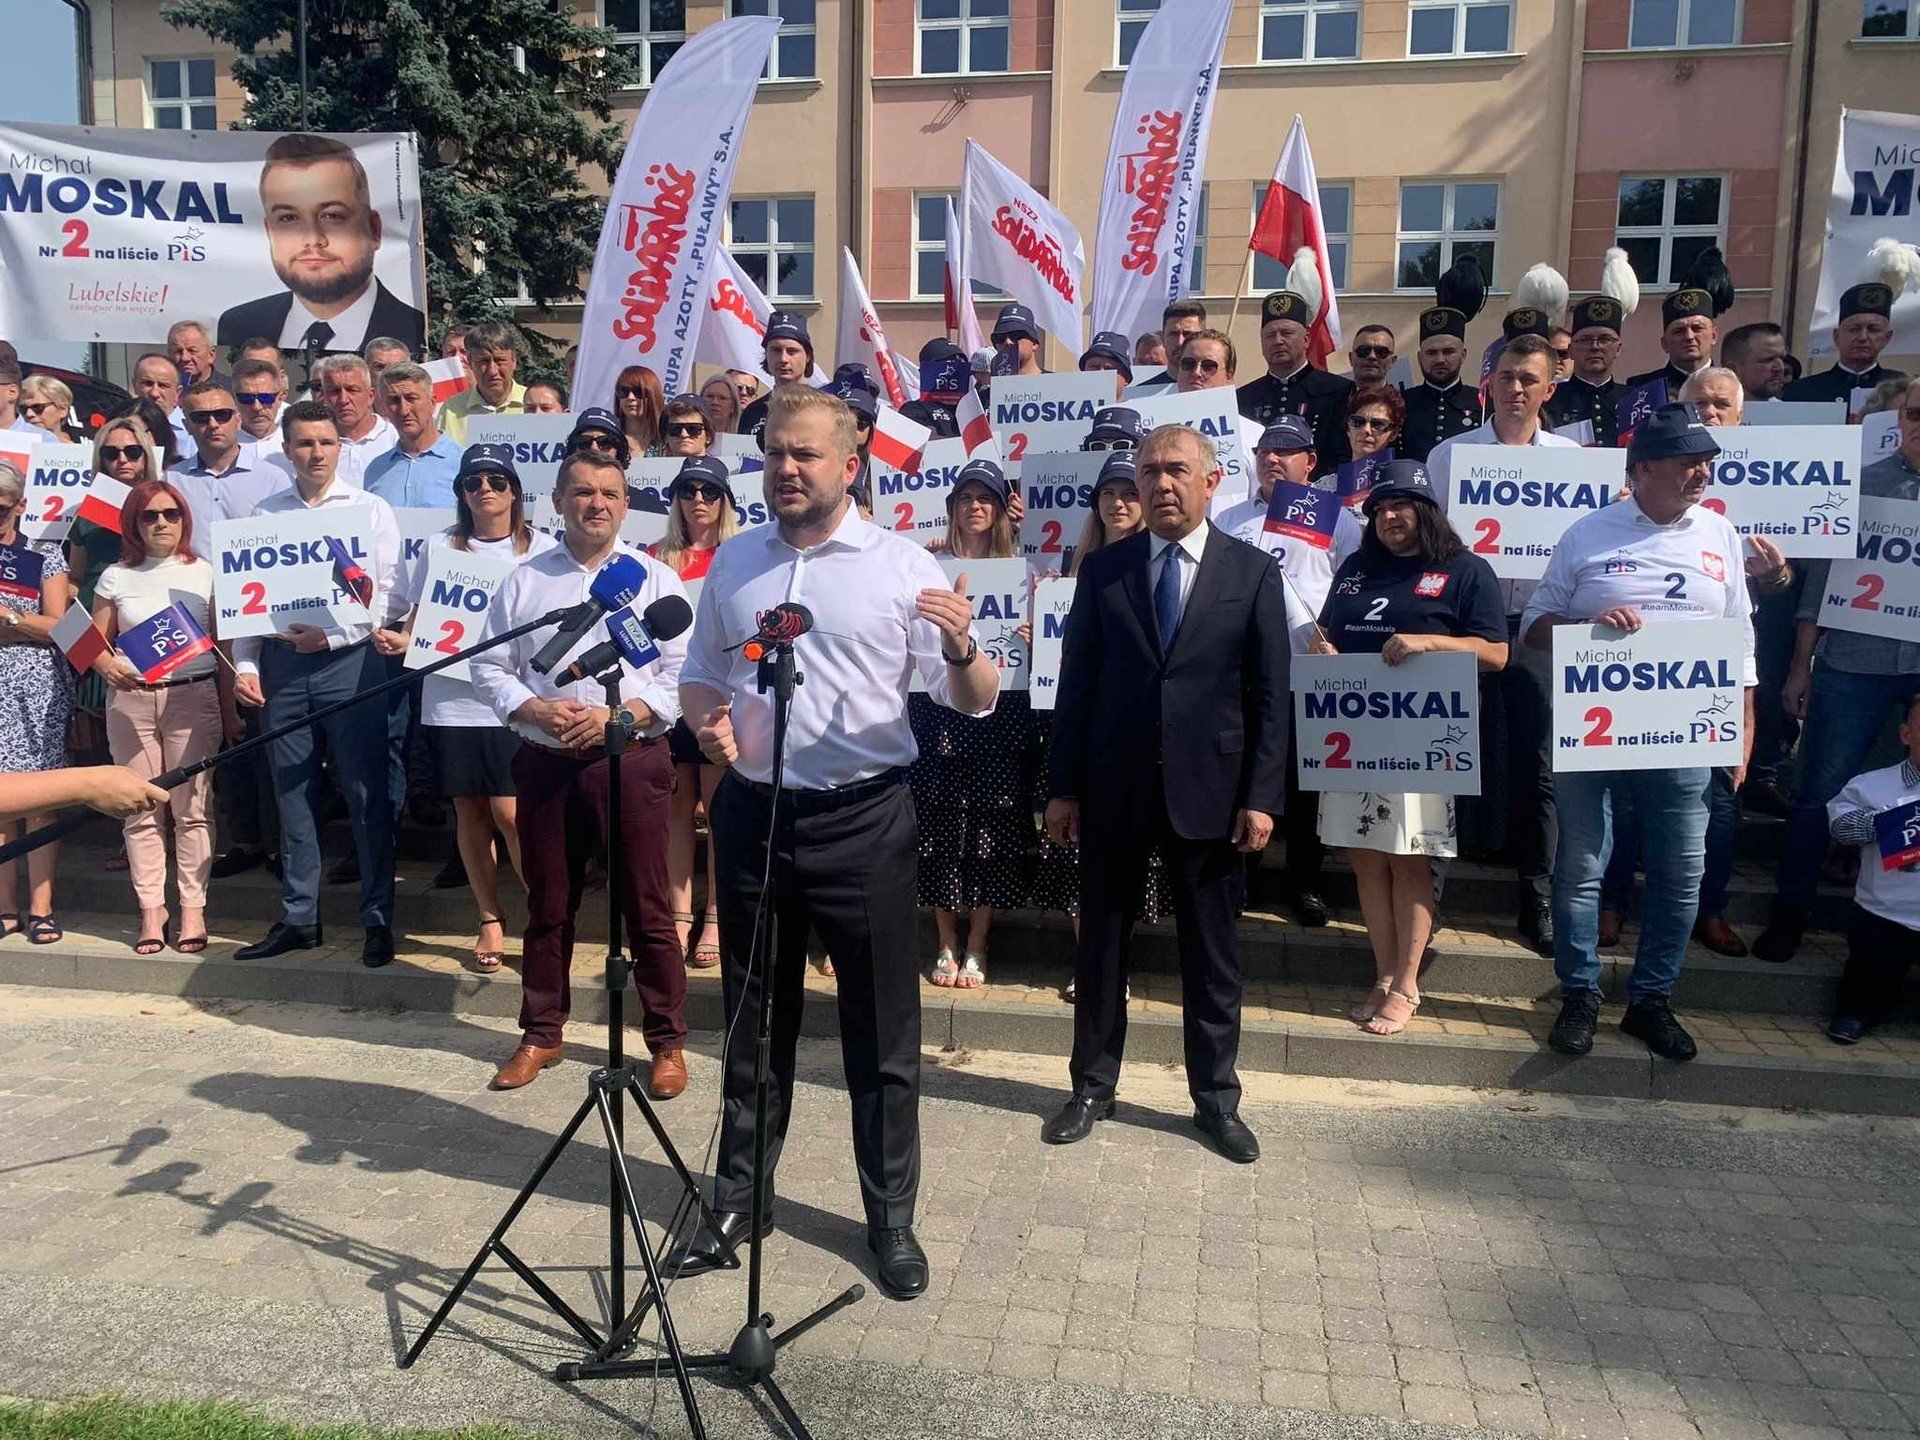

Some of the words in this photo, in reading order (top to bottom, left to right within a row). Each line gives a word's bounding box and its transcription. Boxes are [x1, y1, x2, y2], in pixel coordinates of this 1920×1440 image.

[9, 152, 92, 175] Michał
[0, 172, 244, 225] MOSKAL
[1012, 196, 1039, 224] NSZZ
[38, 245, 59, 258] Nr
[61, 218, 90, 258] 2
[94, 248, 115, 260] na
[117, 246, 159, 261] liście
[166, 243, 206, 262] PiS
[674, 273, 698, 341] AZOTY
[713, 125, 735, 164] S.A.
[1173, 195, 1189, 258] AZOTY
[1004, 391, 1042, 403] Michał
[996, 399, 1106, 425] MOSKA
[479, 432, 517, 443] Michał
[483, 447, 491, 456] 2
[1009, 432, 1028, 461] 2
[1036, 472, 1078, 485] Michał
[1470, 466, 1523, 480] Michał
[1459, 479, 1612, 510] MOSKAL
[25, 513, 39, 523] Nr
[42, 495, 65, 523] 2
[894, 501, 916, 532] 2
[917, 520, 933, 530] na
[1283, 504, 1317, 527] PiS
[1023, 544, 1038, 555] Nr
[1040, 519, 1064, 554] 2
[1473, 517, 1502, 555] 2
[1503, 545, 1524, 557] na
[1754, 521, 1797, 536] liście
[1801, 515, 1851, 536] PiS
[1862, 520, 1919, 539] Michał
[230, 533, 279, 549] Michał
[446, 569, 496, 590] Michał
[1604, 561, 1638, 575] PiS
[430, 580, 495, 613] MO
[1663, 571, 1687, 600] 2
[1827, 593, 1847, 608] Nr
[1850, 573, 1885, 612] 2
[1883, 604, 1906, 618] na
[221, 607, 238, 619] Nr
[240, 581, 268, 616] 2
[271, 601, 290, 613] na
[291, 596, 328, 611] liście
[1363, 597, 1390, 621] 2
[151, 629, 189, 658] PiS
[414, 636, 433, 650] Nr
[434, 619, 465, 656] 2
[1575, 648, 1633, 664] Michał
[1036, 675, 1055, 687] Nr
[1313, 677, 1368, 692] Michał
[1564, 659, 1737, 694] MOSKAL
[1304, 690, 1470, 719] MOSKAL
[1559, 735, 1580, 748] Nr
[1583, 705, 1613, 746] 2
[1617, 735, 1639, 746] na
[1641, 731, 1685, 745] liście
[1688, 720, 1738, 744] PiS
[1302, 757, 1321, 769] Nr
[1323, 731, 1353, 769] 2
[1356, 759, 1377, 770] na
[1378, 756, 1421, 771] liście
[1424, 750, 1474, 772] PiS
